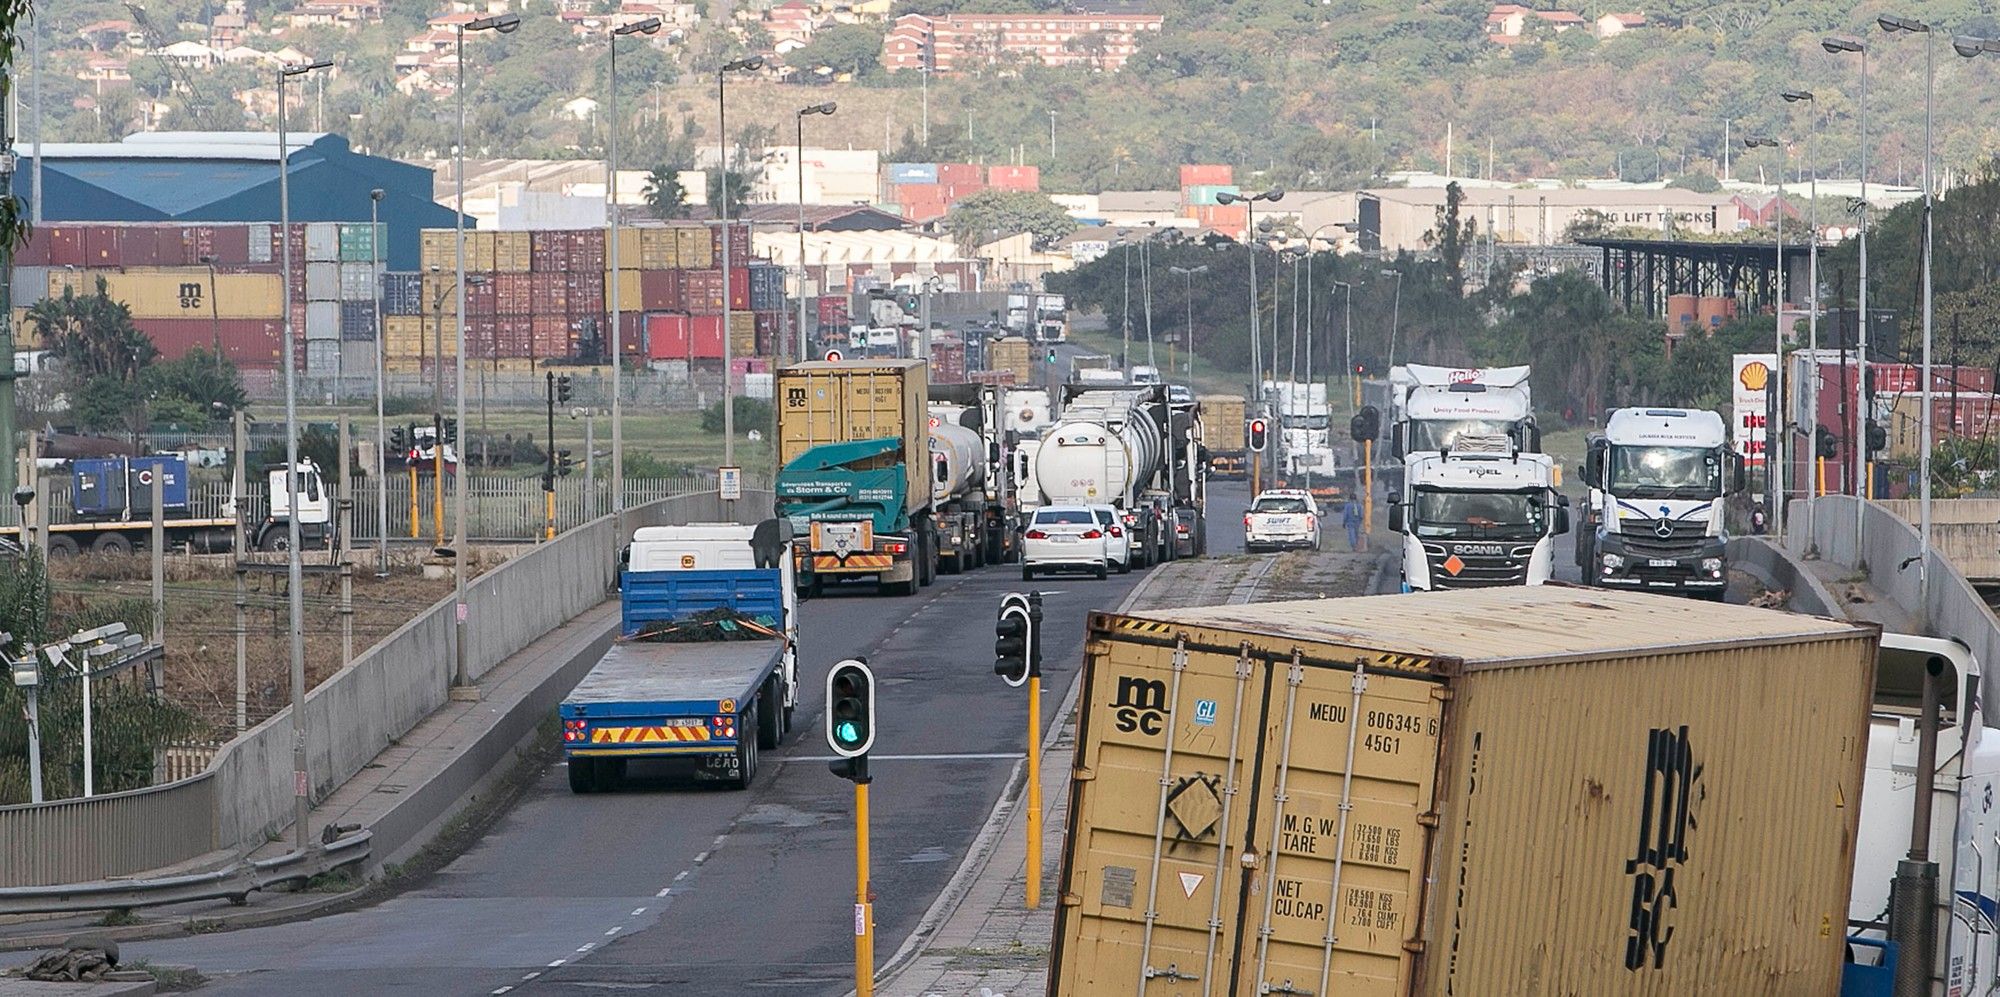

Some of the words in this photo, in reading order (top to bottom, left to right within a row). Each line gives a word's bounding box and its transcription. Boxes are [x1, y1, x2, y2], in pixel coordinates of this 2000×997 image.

[1625, 213, 1651, 222] LIFT
[1453, 545, 1504, 555] SCANIA
[1196, 700, 1216, 718] GL
[1309, 702, 1347, 723] MEDU
[1367, 710, 1421, 734] 806345
[1428, 718, 1437, 736] 6
[1364, 734, 1400, 754] 45G1
[1283, 833, 1317, 853] TARE
[1276, 880, 1303, 898] NET
[1275, 898, 1325, 921] CU.CAP.
